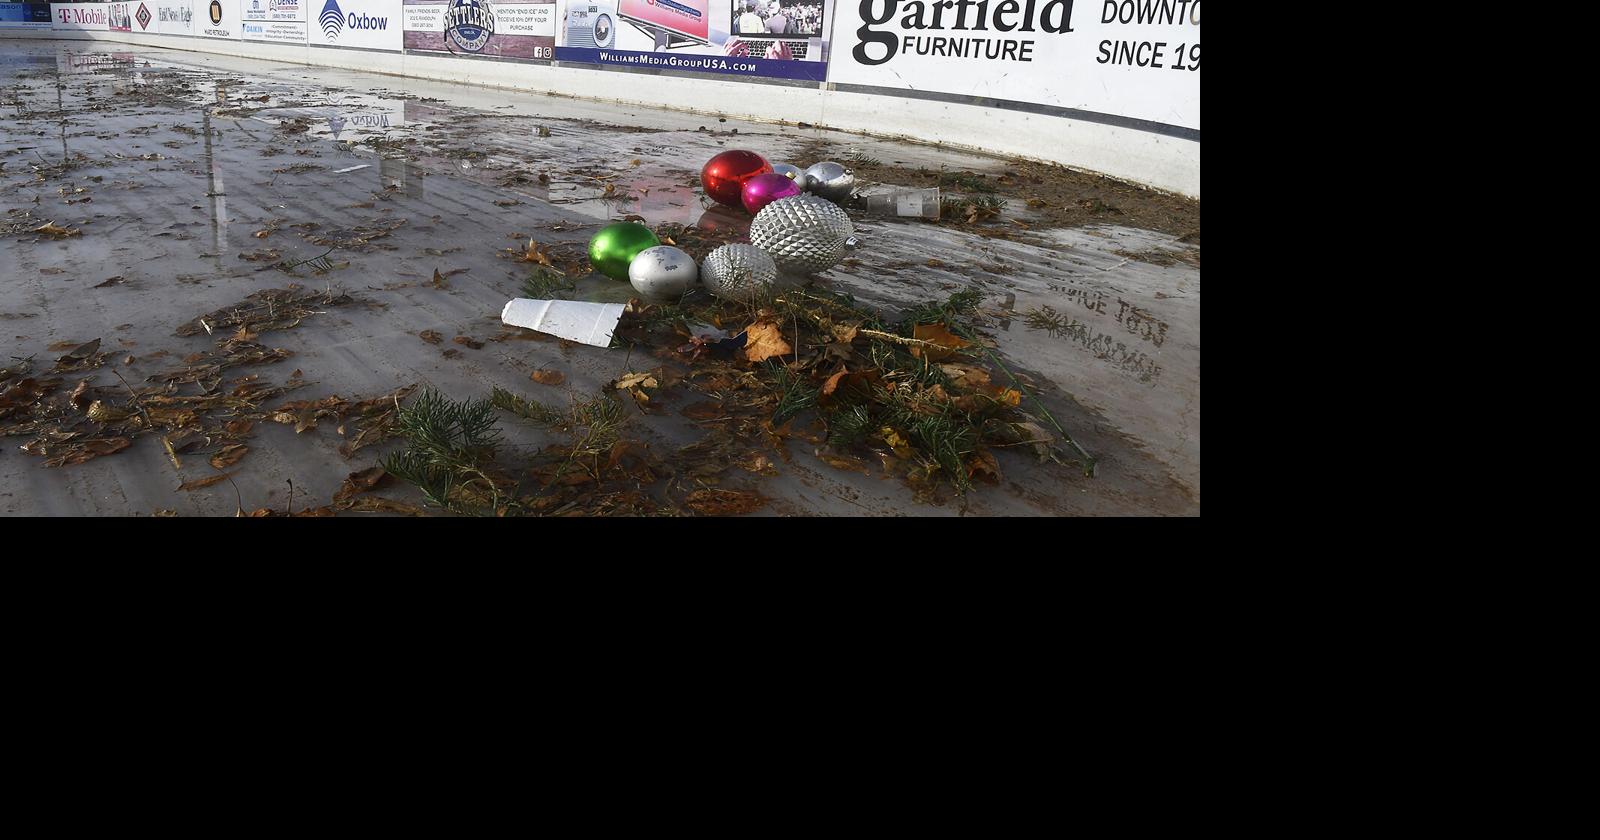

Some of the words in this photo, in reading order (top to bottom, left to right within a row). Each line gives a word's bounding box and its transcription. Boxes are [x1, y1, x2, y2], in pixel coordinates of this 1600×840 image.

[73, 8, 107, 25] Mobile
[348, 12, 388, 31] Oxbow
[443, 5, 494, 33] SETTLERS
[655, 2, 675, 13] Williams
[675, 9, 689, 18] Media
[689, 13, 702, 23] Group
[451, 29, 488, 50] COMPANY
[852, 0, 1075, 66] garfield
[902, 36, 1035, 62] FURNITURE
[1096, 39, 1167, 69] SINCE
[1171, 42, 1200, 72] 19
